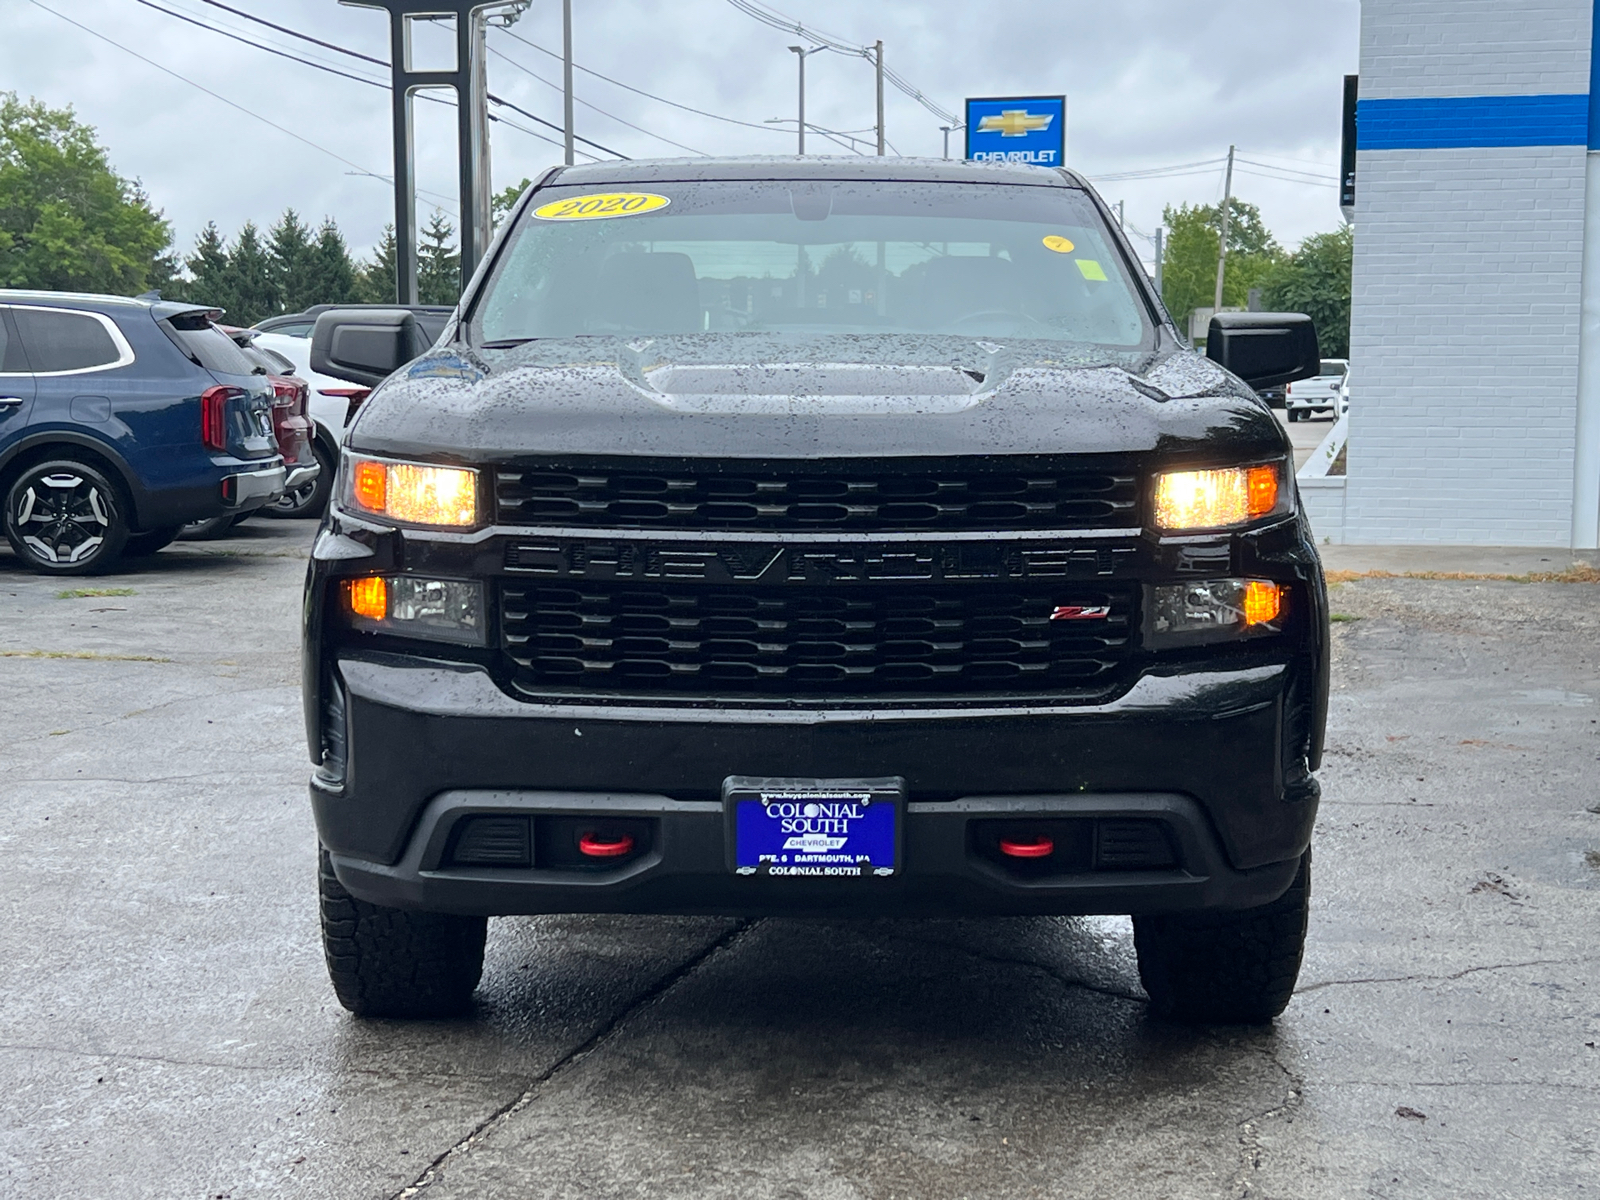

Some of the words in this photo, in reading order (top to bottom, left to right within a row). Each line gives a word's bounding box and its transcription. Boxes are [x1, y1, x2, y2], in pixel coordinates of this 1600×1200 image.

[973, 150, 1057, 163] CHEVROLET
[553, 196, 648, 217] 2020
[502, 544, 1137, 581] CHEVROLET
[1050, 606, 1110, 620] Z71
[766, 803, 864, 818] COLONIAL
[781, 818, 848, 833] SOUTH
[789, 839, 841, 847] CHEVROLET
[781, 854, 787, 863] 6
[794, 854, 854, 863] DARTMOUTH,
[768, 866, 823, 876] COLONIAL
[824, 866, 861, 876] SOUTH
